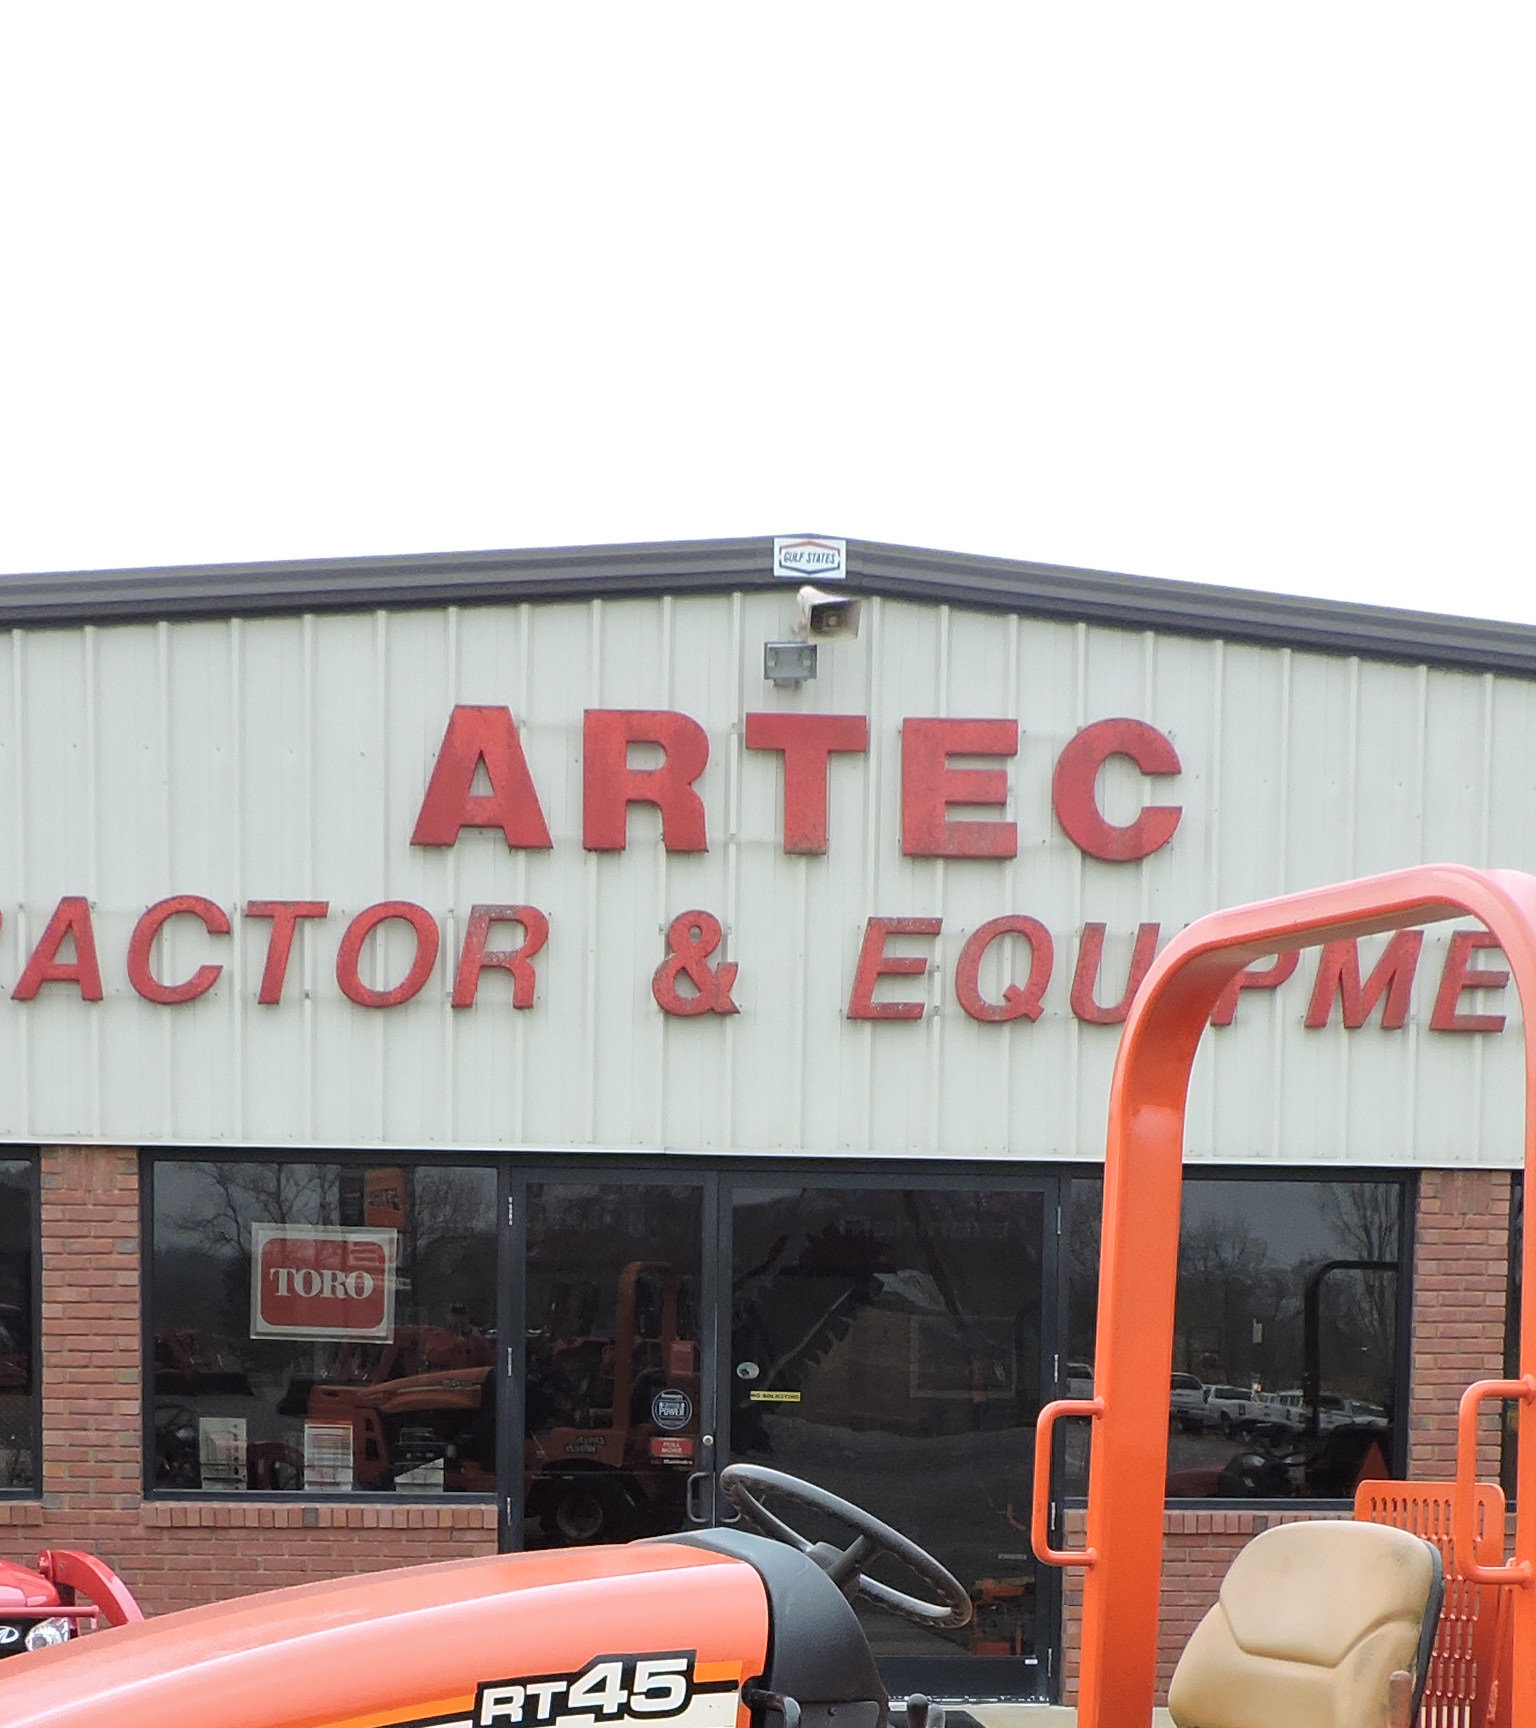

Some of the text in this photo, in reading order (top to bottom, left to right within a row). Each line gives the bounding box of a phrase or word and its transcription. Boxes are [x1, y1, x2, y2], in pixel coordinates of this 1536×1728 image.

[806, 551, 836, 565] STATES
[410, 704, 1183, 862] ARTEC
[652, 909, 742, 1018] &
[269, 1267, 374, 1300] TORO
[480, 1658, 688, 1726] RT45
